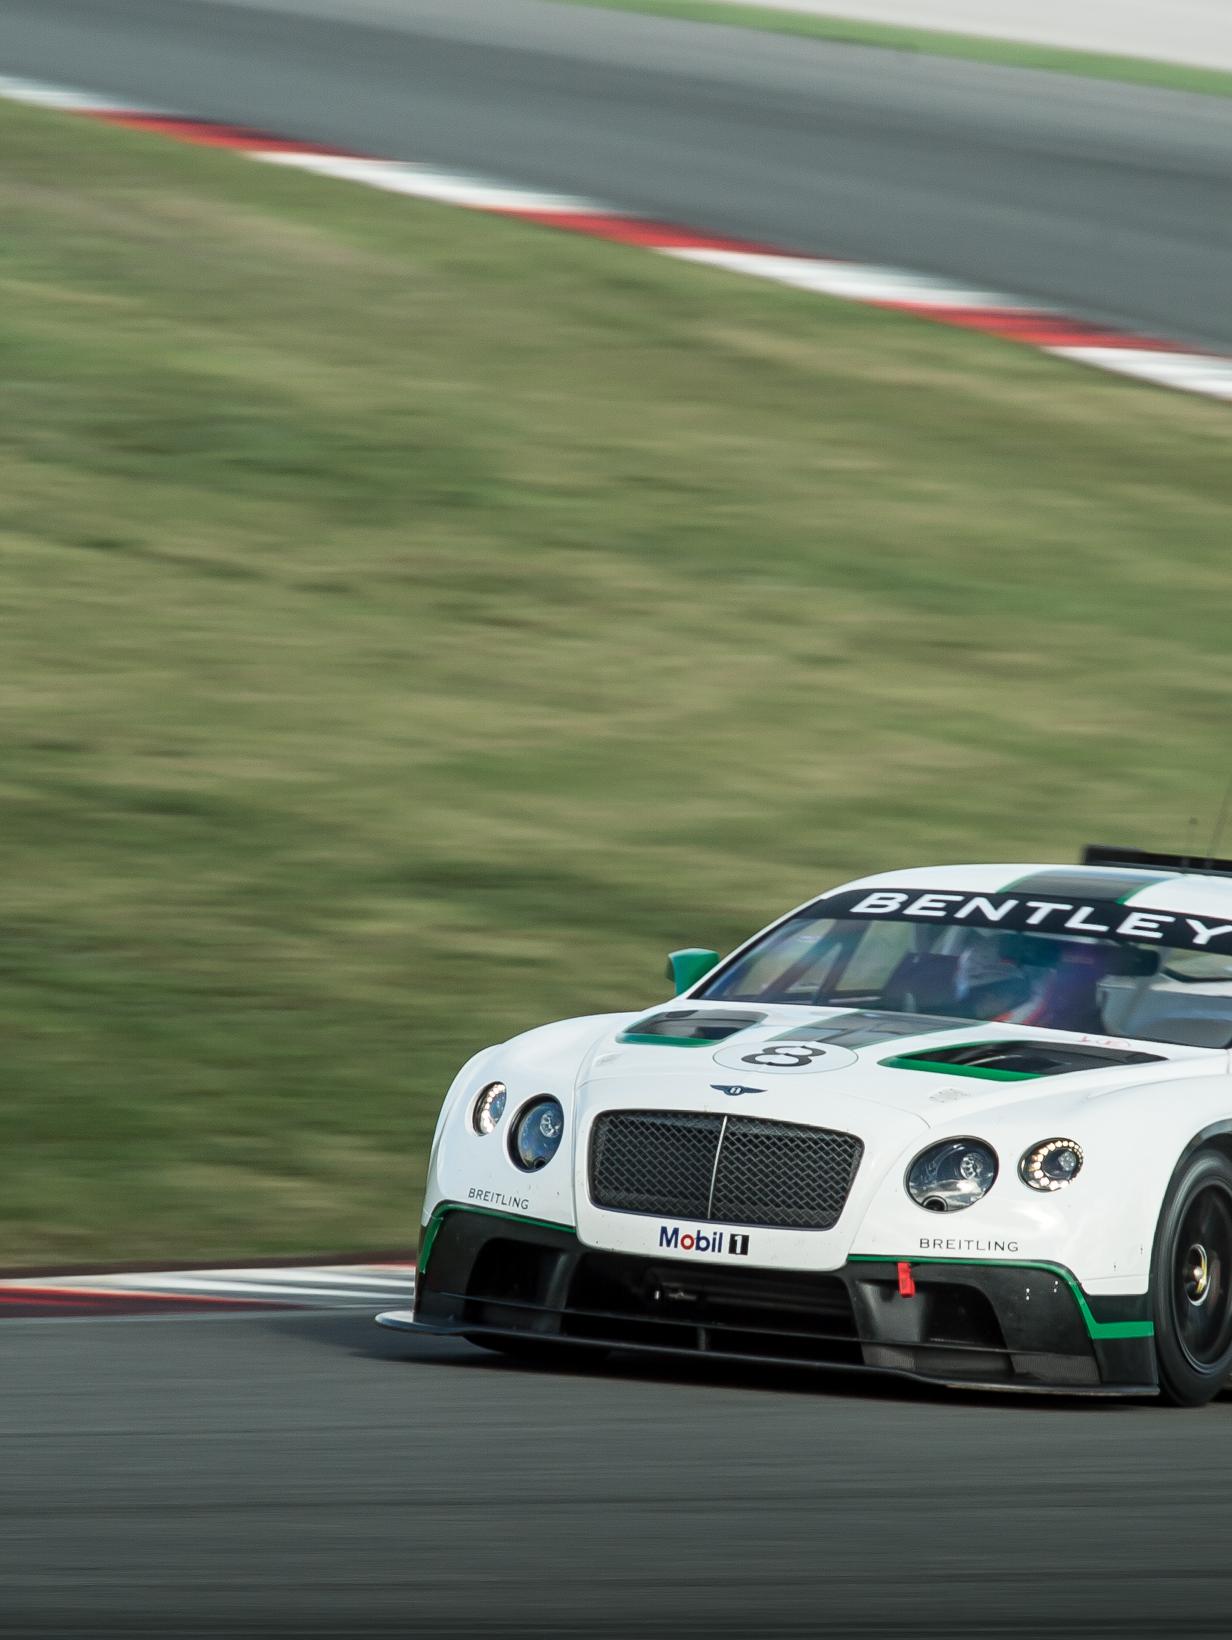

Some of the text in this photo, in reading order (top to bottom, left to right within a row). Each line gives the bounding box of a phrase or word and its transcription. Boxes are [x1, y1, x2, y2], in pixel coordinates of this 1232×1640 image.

[741, 1045, 826, 1067] 8
[468, 1187, 529, 1210] BREITLING
[659, 1226, 723, 1253] Mobil
[919, 1238, 1018, 1252] BREITLING
